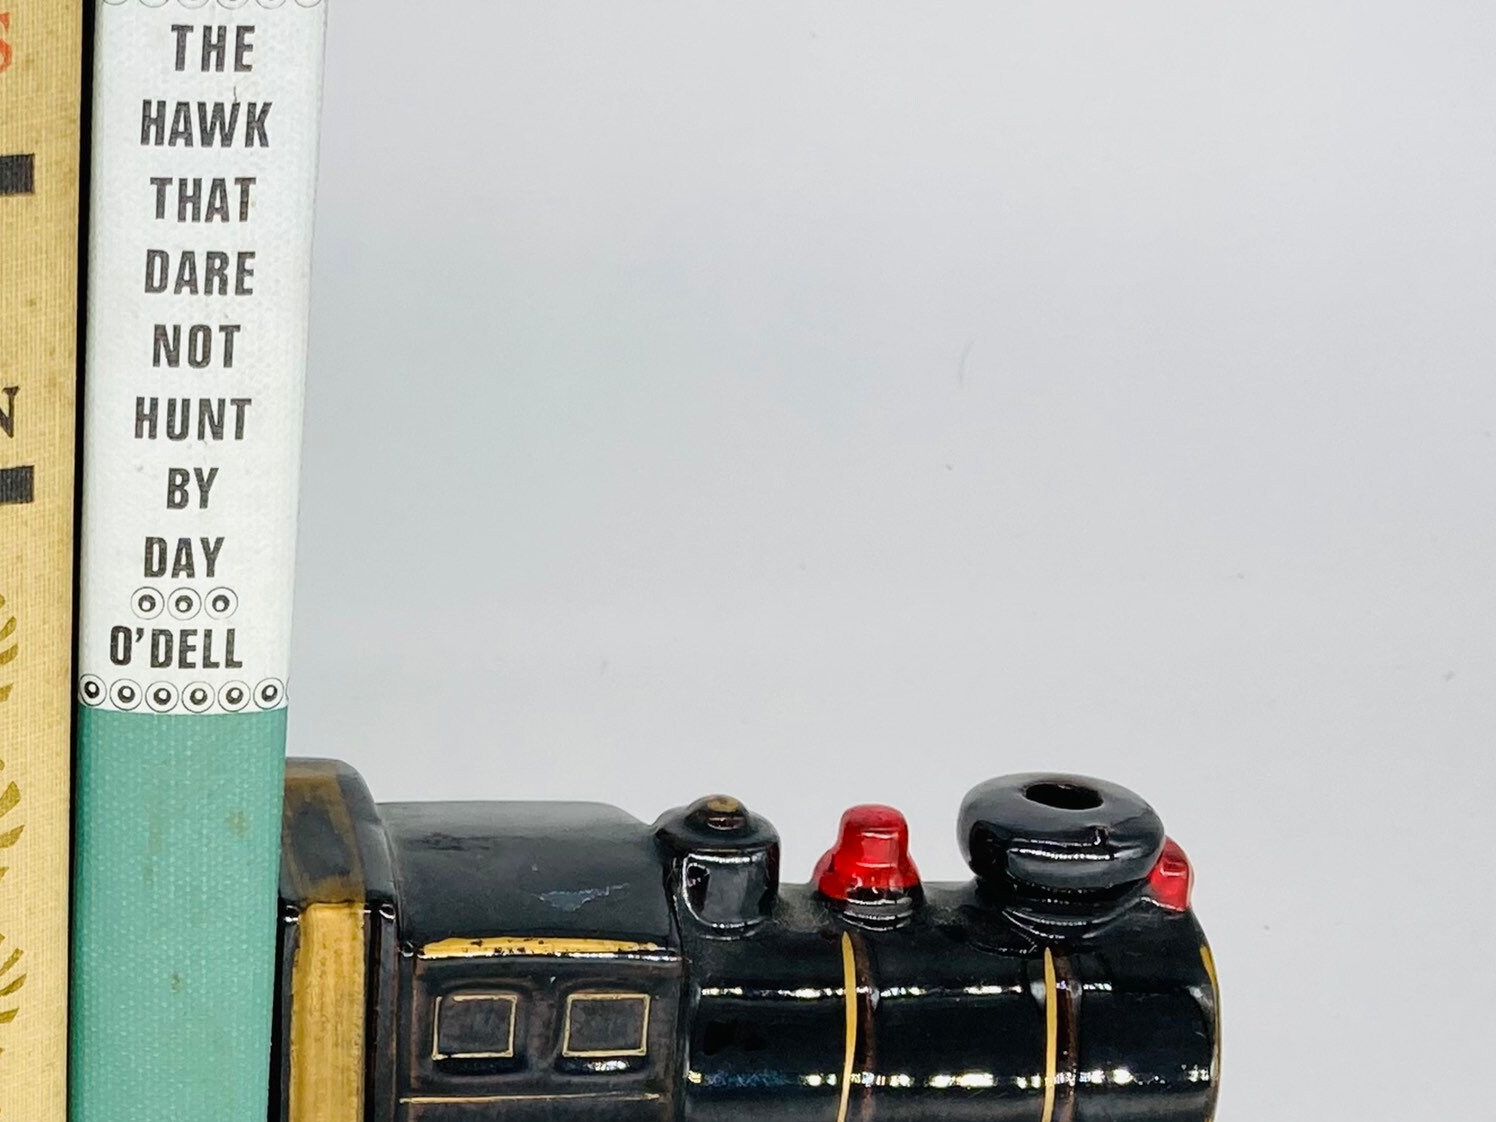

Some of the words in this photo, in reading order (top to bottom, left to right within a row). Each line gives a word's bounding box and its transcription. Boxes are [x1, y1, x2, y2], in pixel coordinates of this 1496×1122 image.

[171, 24, 255, 72] THE
[140, 99, 272, 148] HAWK
[150, 177, 256, 223] THAT
[144, 249, 256, 296] DARE
[152, 324, 241, 369] NOT
[134, 397, 252, 441] HUNT
[166, 467, 219, 509] BY
[143, 536, 225, 579] DAY
